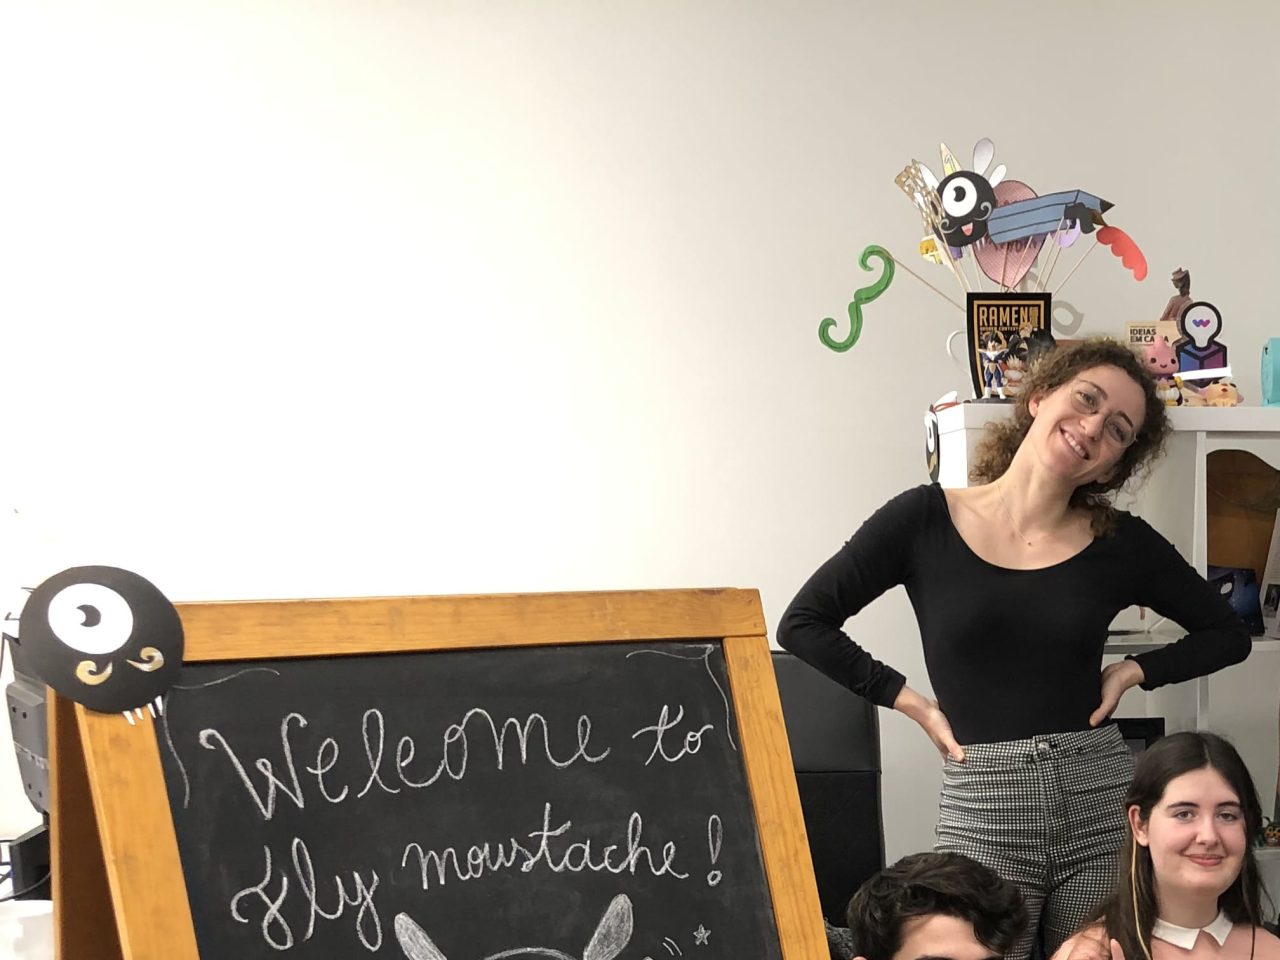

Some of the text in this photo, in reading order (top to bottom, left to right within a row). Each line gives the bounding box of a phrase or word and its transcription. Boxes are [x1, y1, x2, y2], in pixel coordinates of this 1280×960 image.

[979, 306, 1028, 327] RAMEN
[1130, 328, 1157, 336] IDEIAS
[199, 704, 714, 820] Welcome to
